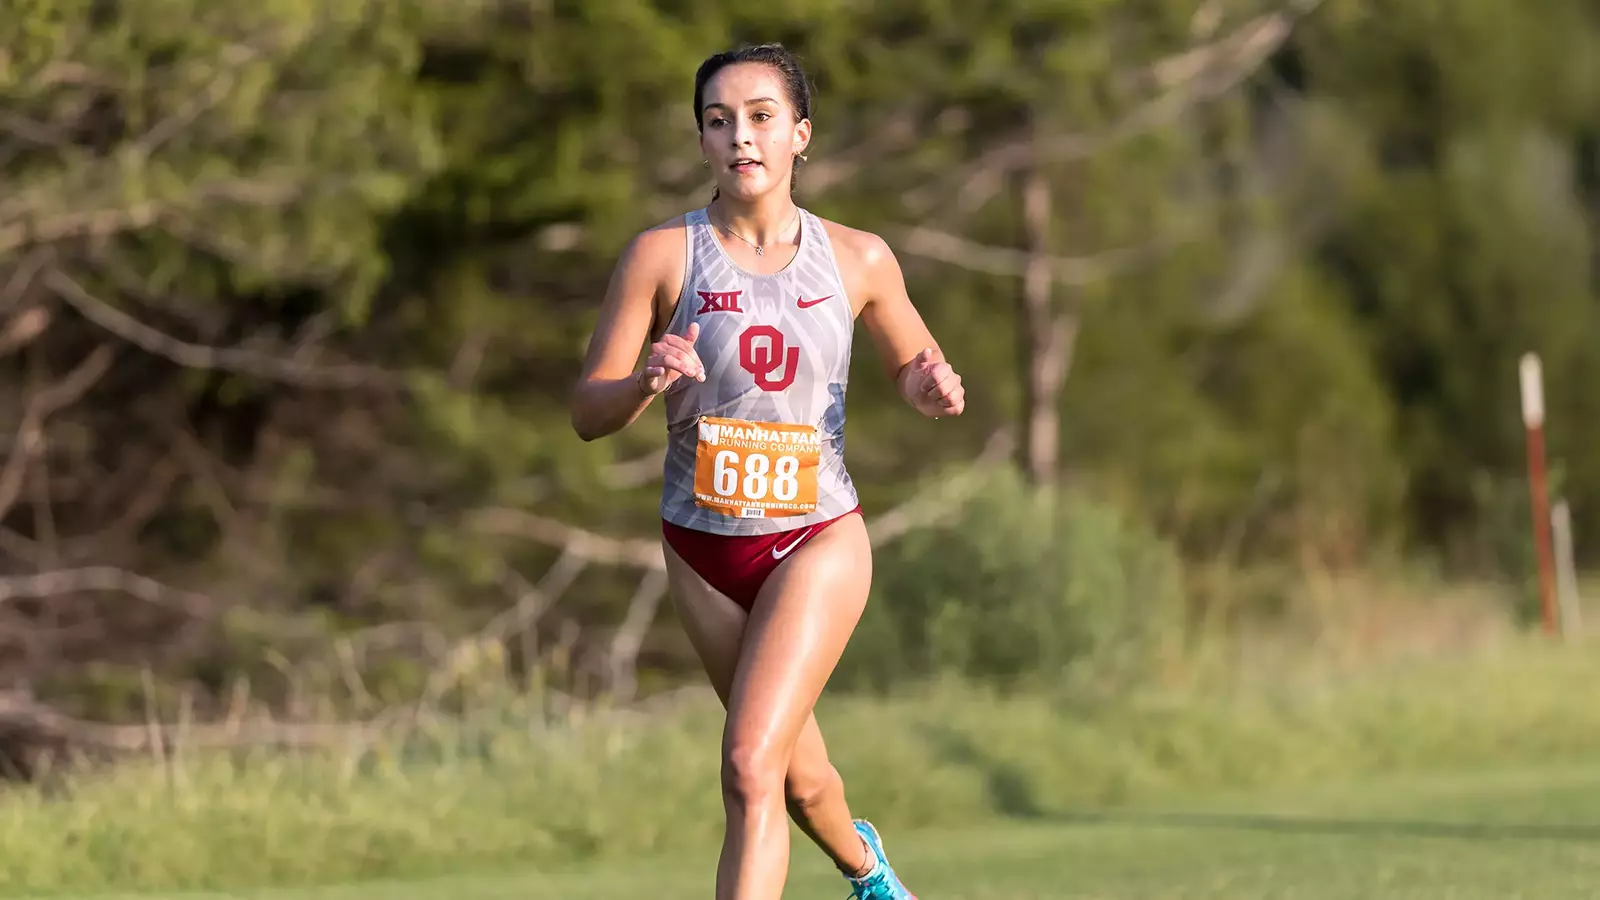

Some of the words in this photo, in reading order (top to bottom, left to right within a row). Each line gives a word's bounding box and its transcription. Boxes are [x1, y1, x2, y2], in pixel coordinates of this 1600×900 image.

[696, 290, 743, 316] XII
[739, 325, 800, 391] OU
[719, 438, 767, 450] RUNNING
[770, 442, 820, 453] COMPANY
[720, 425, 820, 445] MANHATTAN
[713, 450, 799, 501] 688
